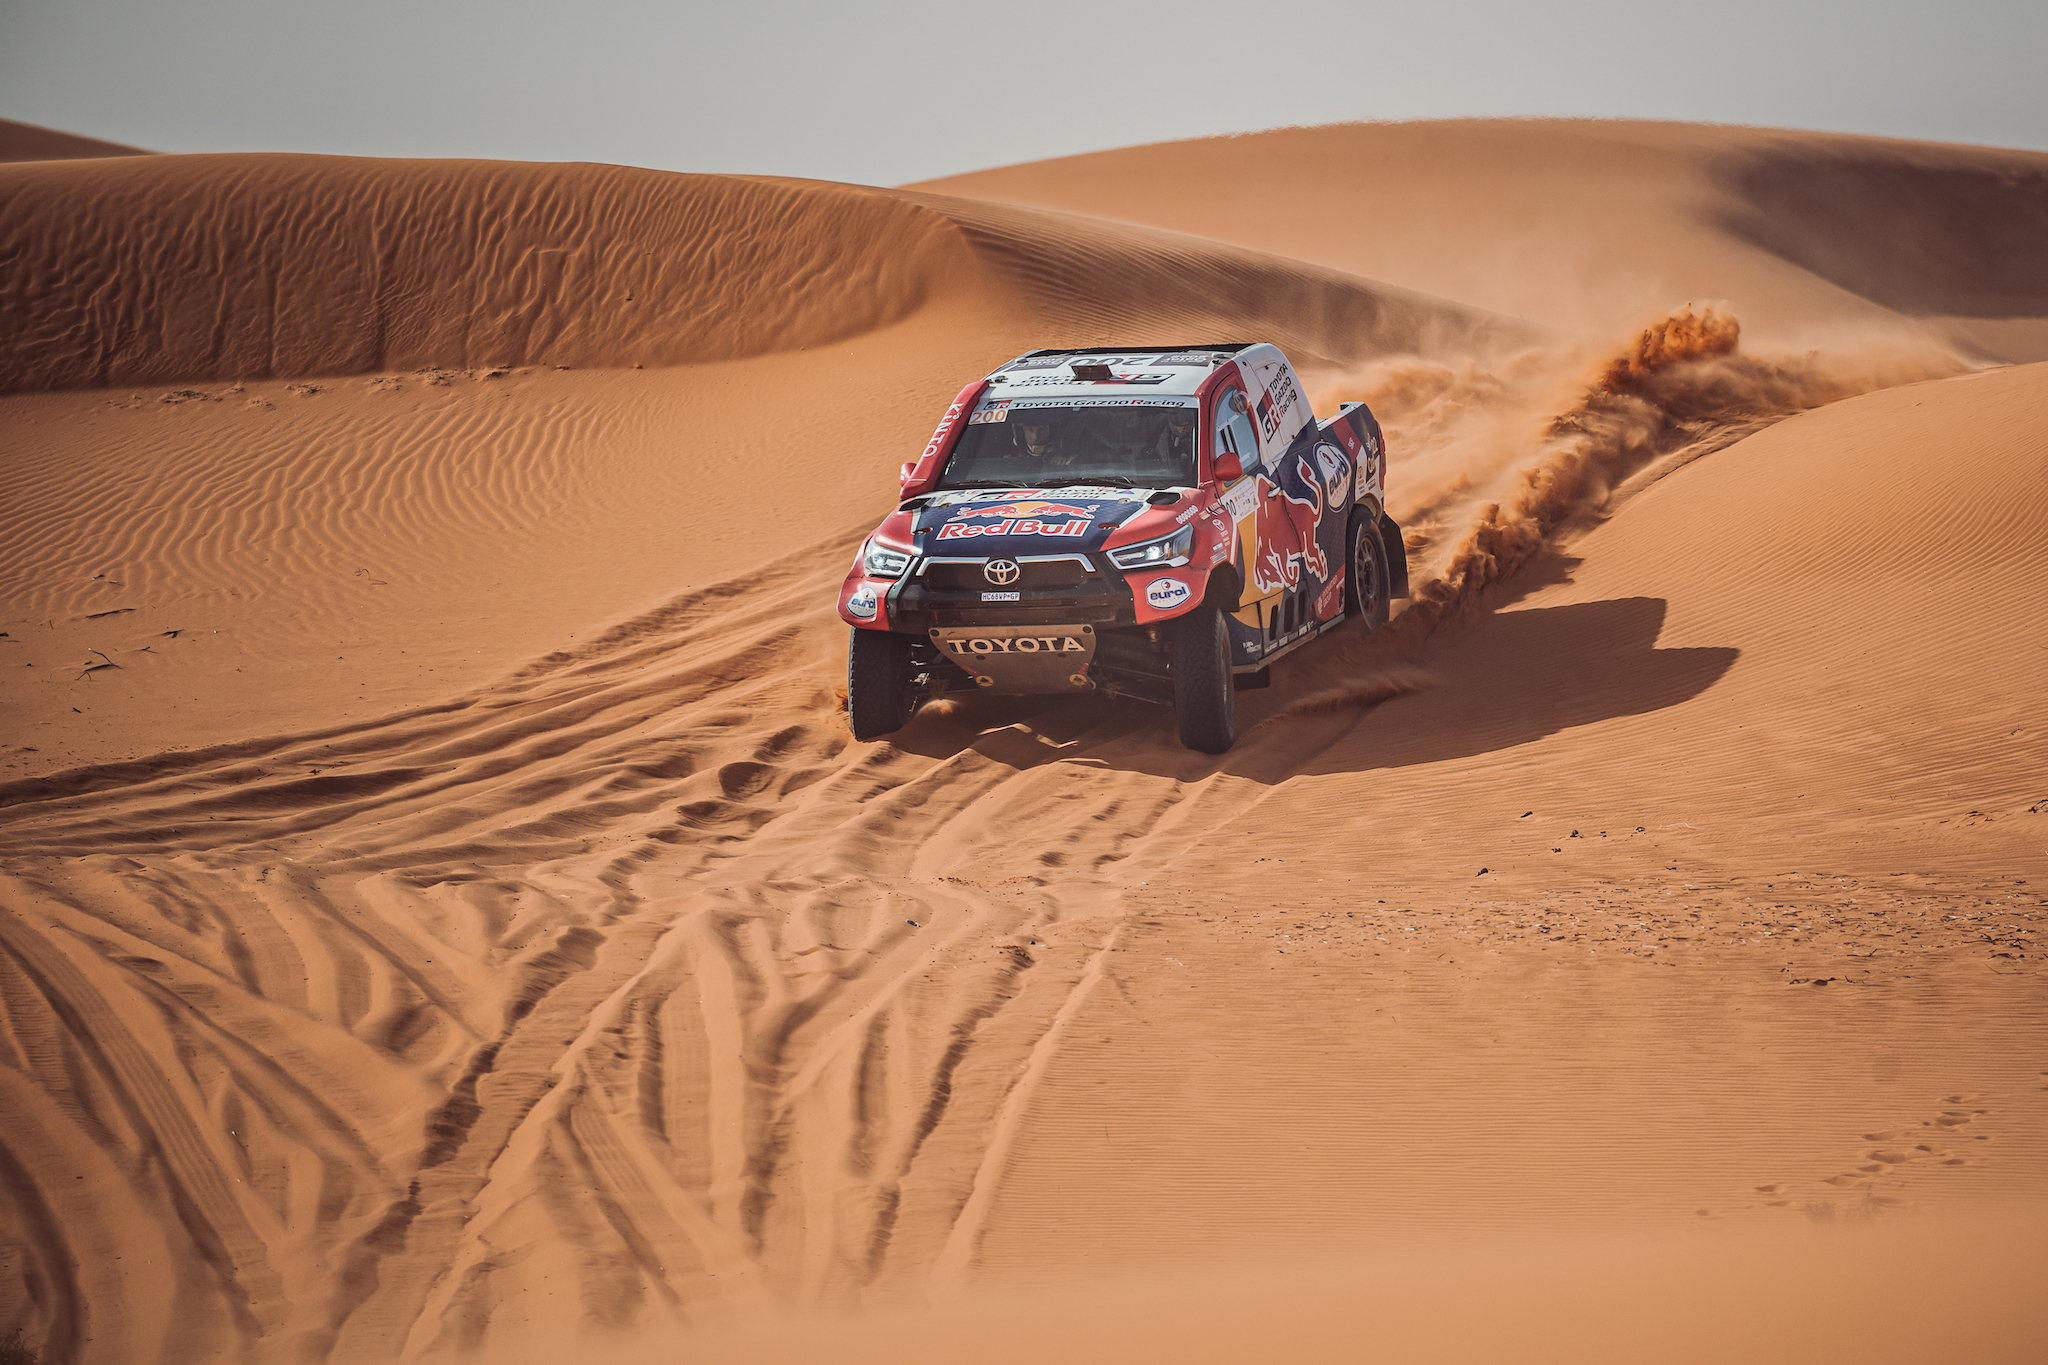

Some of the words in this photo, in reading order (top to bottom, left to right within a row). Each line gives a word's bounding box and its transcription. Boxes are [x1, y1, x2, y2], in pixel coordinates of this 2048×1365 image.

[1269, 363, 1288, 393] TOYOTA
[1274, 376, 1292, 406] GAZOO
[1131, 399, 1186, 407] Racing
[1279, 388, 1298, 419] Racing
[969, 409, 1007, 424] 200
[1262, 403, 1281, 437] GR
[1328, 453, 1350, 497] eurol
[936, 519, 1011, 541] Red
[1011, 519, 1092, 538] Bull
[851, 598, 876, 609] eurol
[1010, 592, 1020, 600] GP
[1150, 586, 1187, 601] eurol
[947, 637, 1086, 655] TOYOTA
